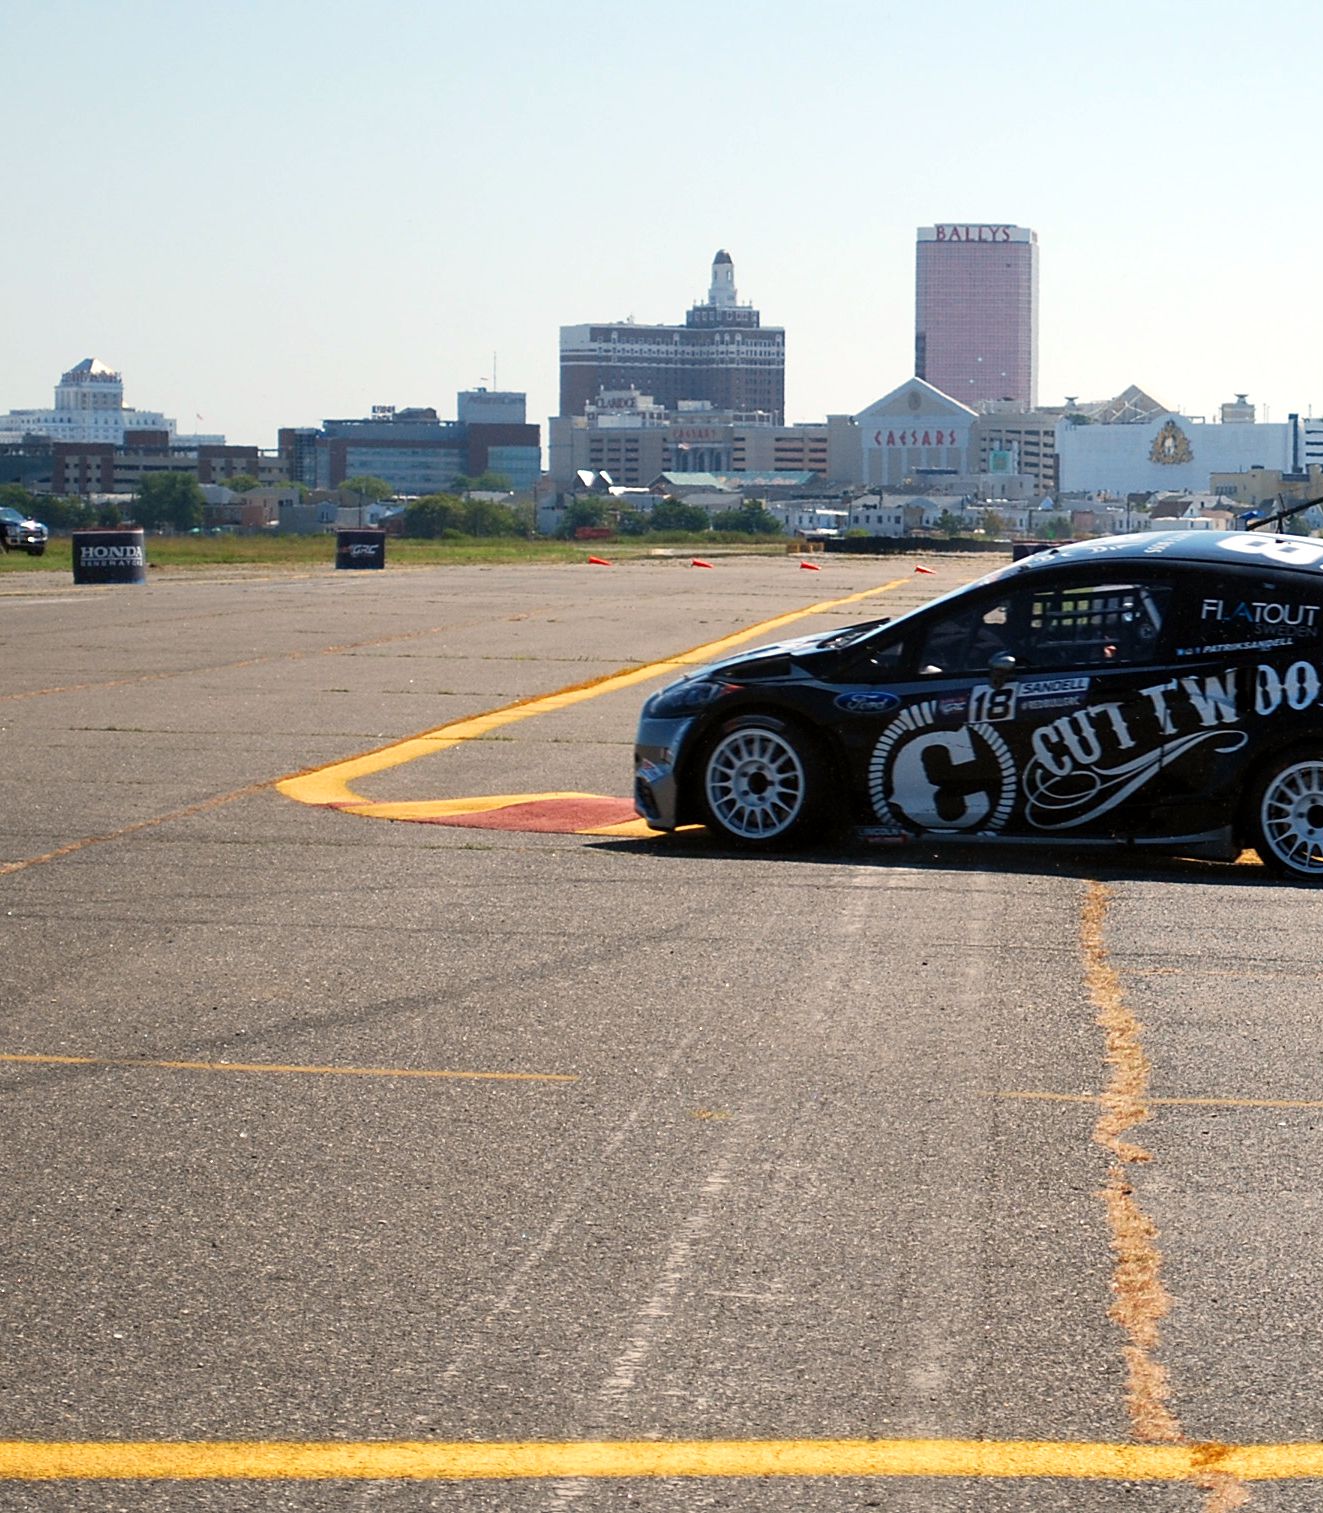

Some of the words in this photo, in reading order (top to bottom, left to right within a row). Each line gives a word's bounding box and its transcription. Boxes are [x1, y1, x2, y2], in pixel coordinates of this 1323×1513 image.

[935, 226, 1011, 242] BALLYS
[874, 430, 956, 446] CAESARS
[81, 546, 143, 558] HONDA
[1201, 599, 1321, 621] FLATOUT
[1254, 624, 1318, 637] SWEDEN
[1022, 679, 1086, 695] SANDELL
[847, 693, 889, 711] Ford
[974, 688, 1013, 721] 18
